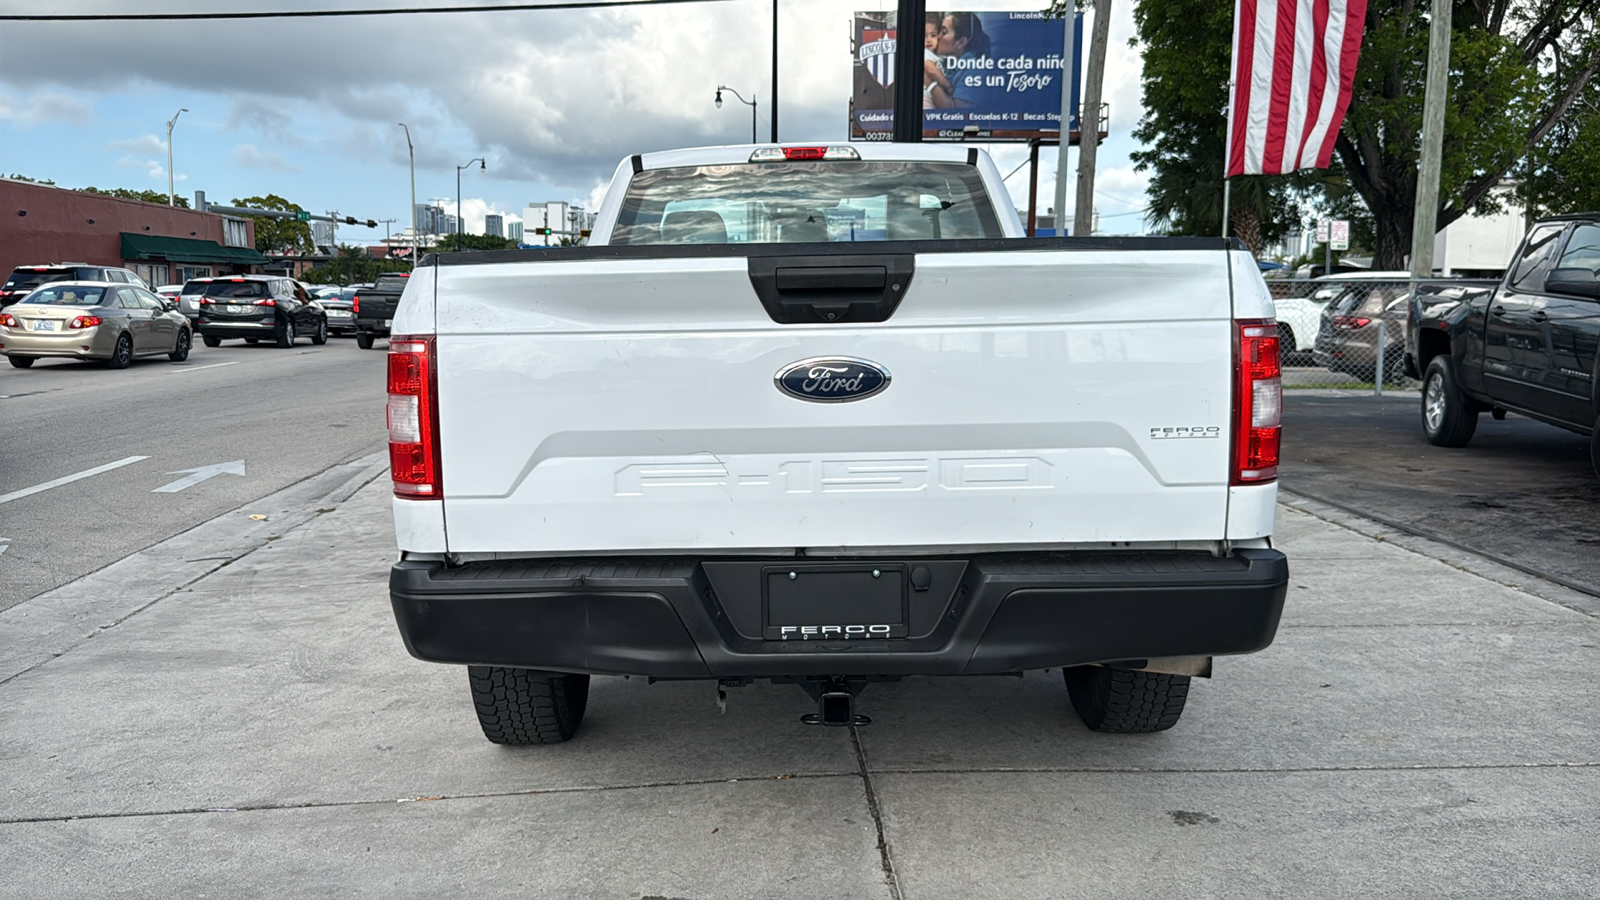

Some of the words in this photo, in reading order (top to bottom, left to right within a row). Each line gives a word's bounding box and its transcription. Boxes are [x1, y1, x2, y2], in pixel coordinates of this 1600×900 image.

[946, 54, 994, 70] Donde
[997, 54, 1033, 70] cada
[964, 75, 982, 87] es
[986, 75, 1005, 87] un
[1006, 70, 1052, 93] Tesoro
[859, 113, 889, 122] Cuidado
[942, 112, 964, 121] Gratis
[969, 112, 1000, 121] Escuelas
[1002, 113, 1018, 121] K-12
[1023, 113, 1045, 121] Becas
[801, 366, 865, 392] Ford
[613, 456, 1056, 497] F-150
[781, 624, 891, 634] FERCO
